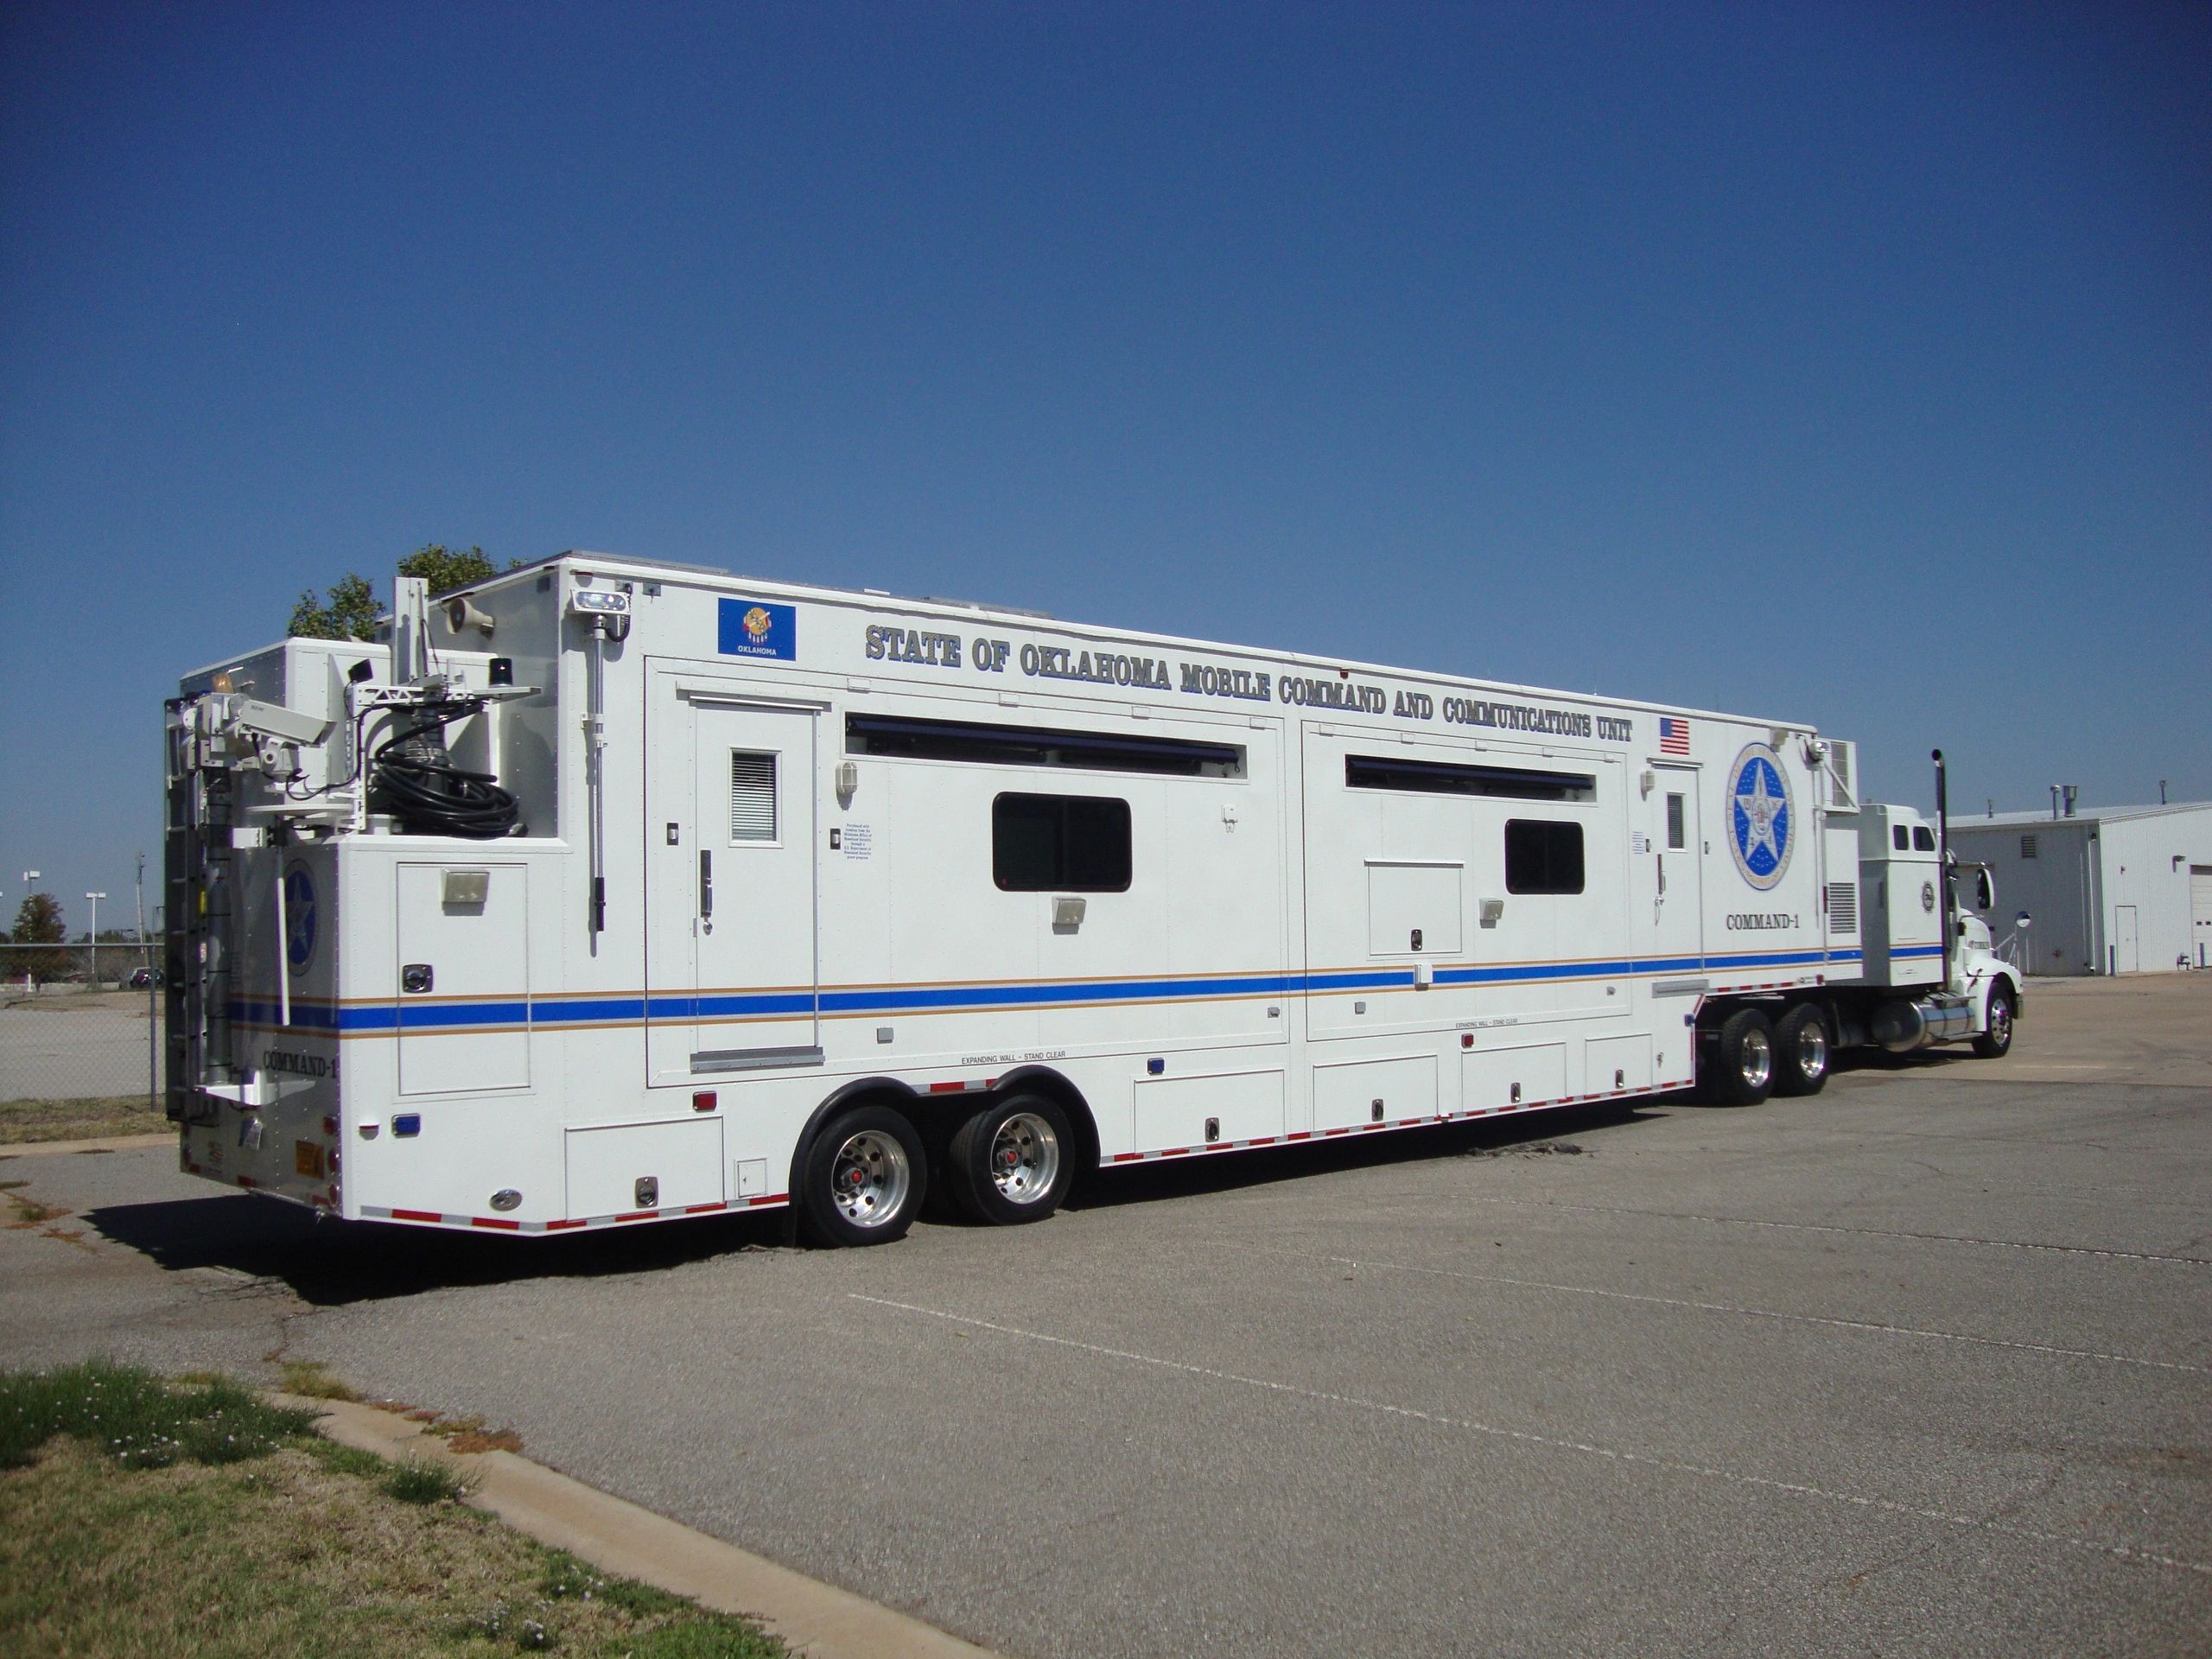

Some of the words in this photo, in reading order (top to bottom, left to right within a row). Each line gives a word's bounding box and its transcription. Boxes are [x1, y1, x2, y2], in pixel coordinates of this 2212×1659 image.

[737, 645, 777, 656] OKLAHOMA
[866, 625, 961, 668] STATE
[972, 638, 1010, 672] OF
[1020, 643, 1172, 690] OKLAHOMA
[1180, 663, 1271, 702] MOBILE
[1279, 676, 1386, 715] COMMAND
[1393, 690, 1433, 720] AND
[1443, 696, 1592, 738] COMMUNICATIONS
[1597, 715, 1632, 741] UNIT
[1726, 914, 1799, 930] COMMAND-1
[263, 1050, 336, 1079] COMMAND-1
[961, 1055, 997, 1065] EXPANDING
